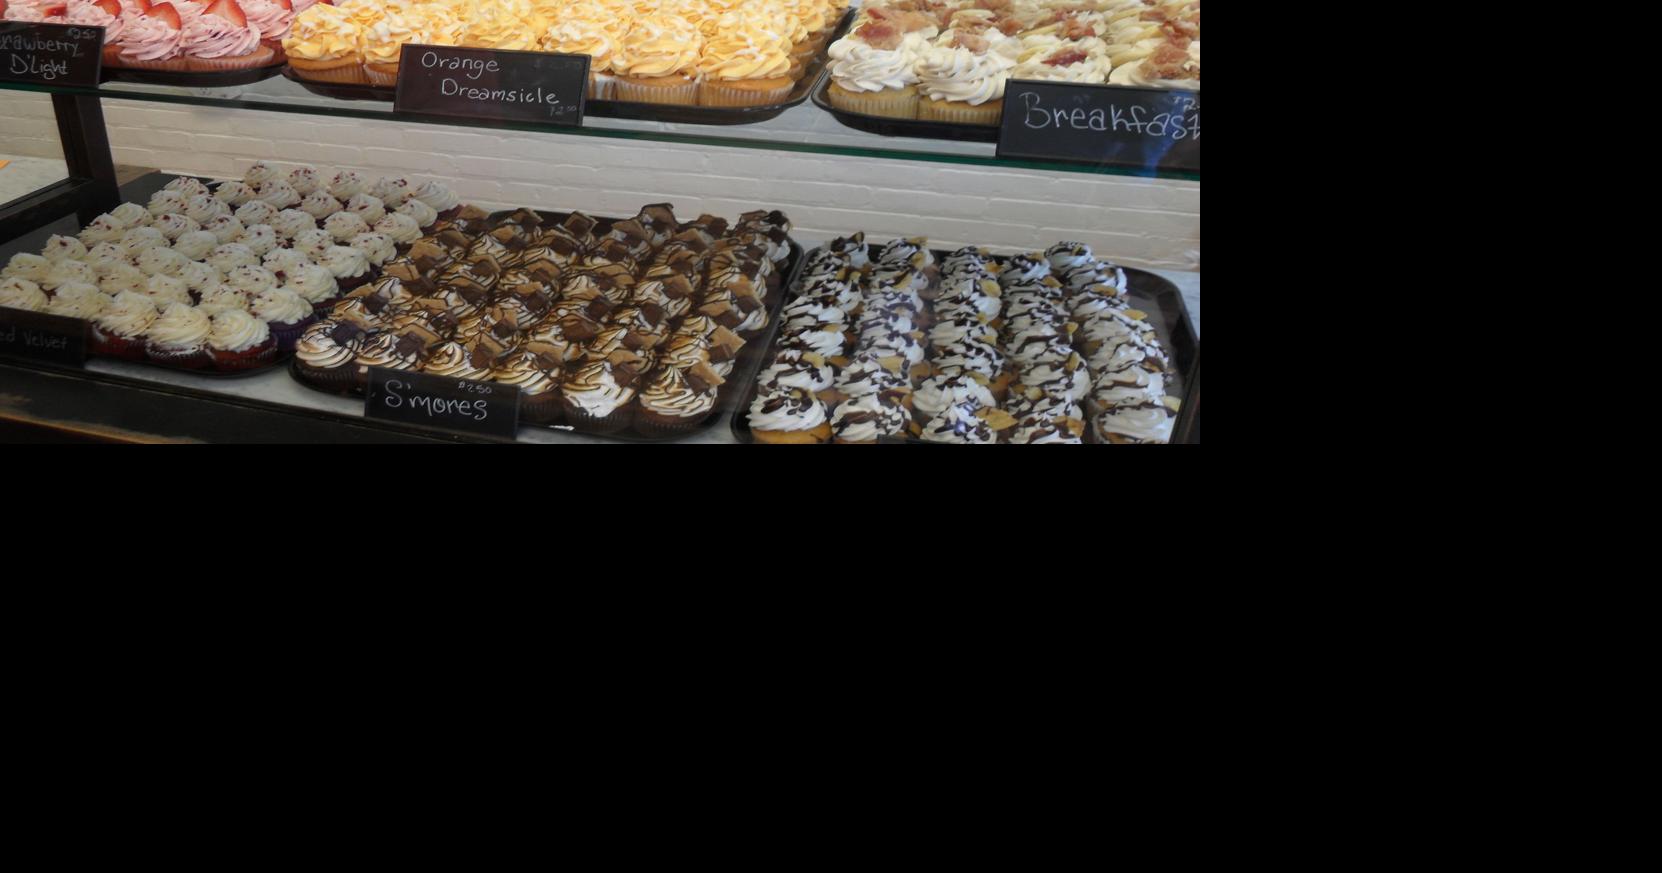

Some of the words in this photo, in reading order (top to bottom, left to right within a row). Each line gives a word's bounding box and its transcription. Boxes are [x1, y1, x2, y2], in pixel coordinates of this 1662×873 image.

[0, 32, 84, 58] rawberry
[421, 51, 500, 80] Orange
[441, 78, 560, 105] Dreamsicle
[1018, 91, 1200, 141] Breakfast
[23, 329, 68, 350] Velvet
[385, 379, 487, 421] S'mores
